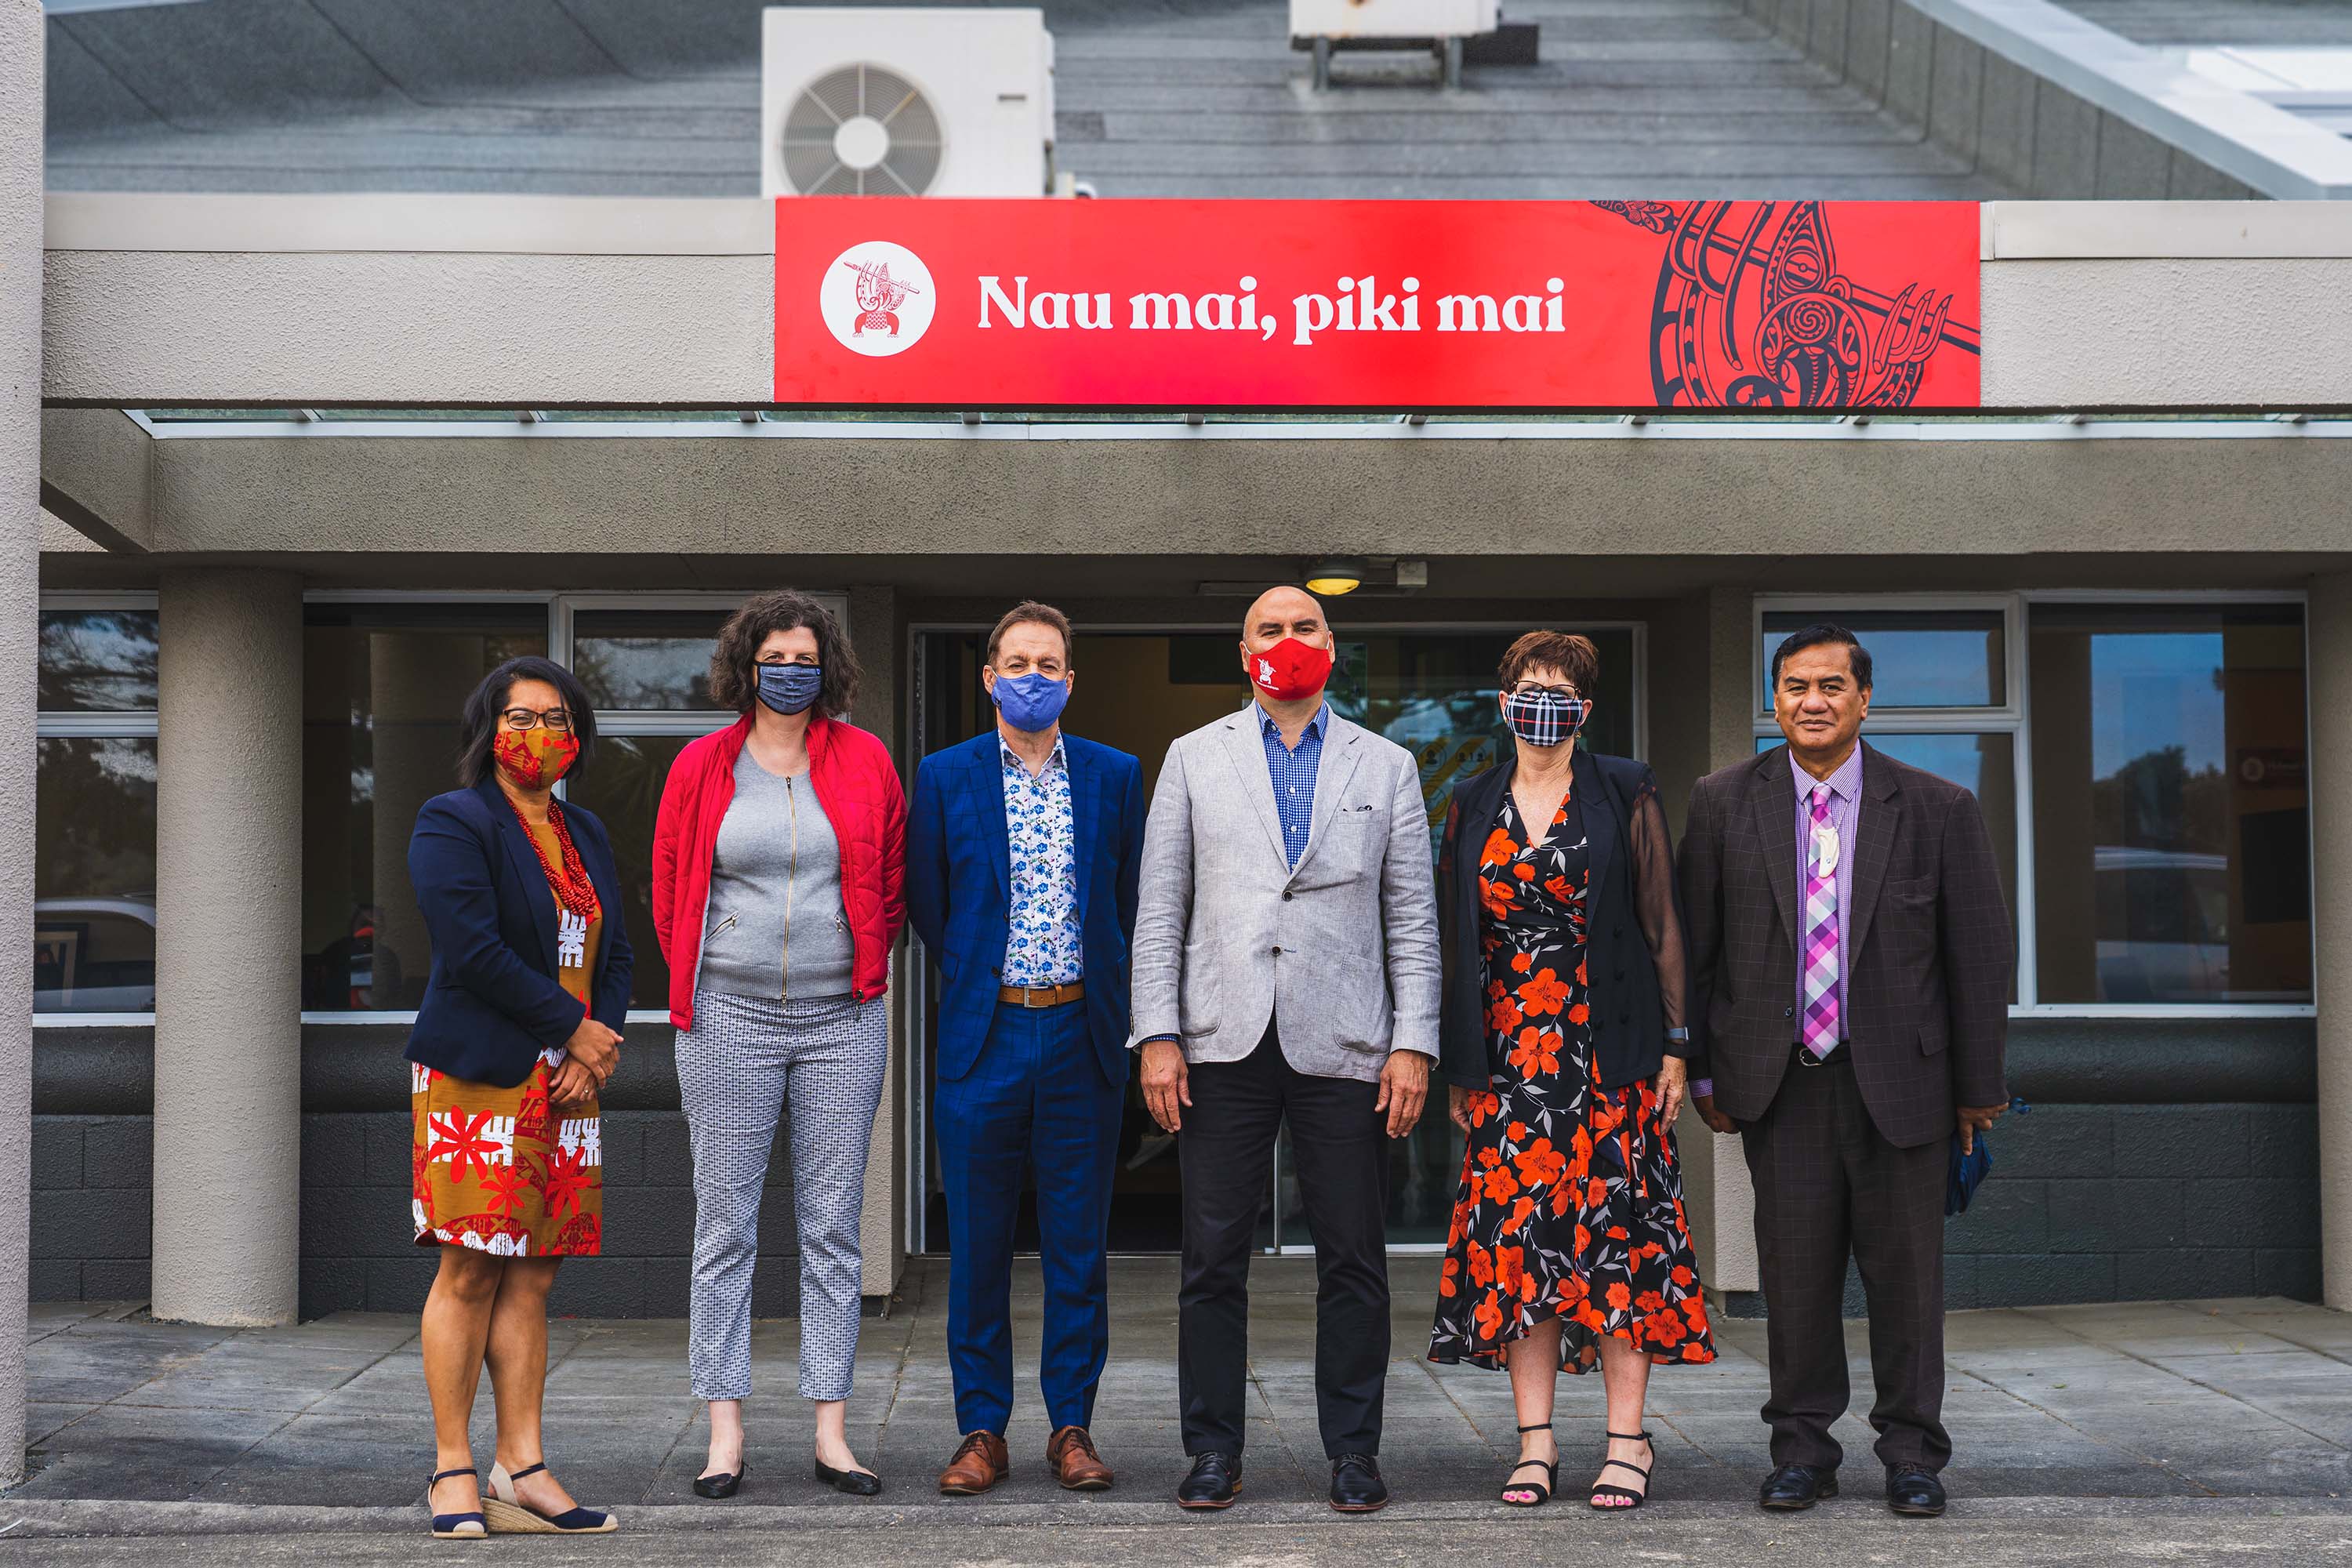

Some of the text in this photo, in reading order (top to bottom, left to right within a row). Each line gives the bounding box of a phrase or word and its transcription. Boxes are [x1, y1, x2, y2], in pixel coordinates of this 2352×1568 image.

[978, 275, 1566, 346] Nau mai, piki mai
